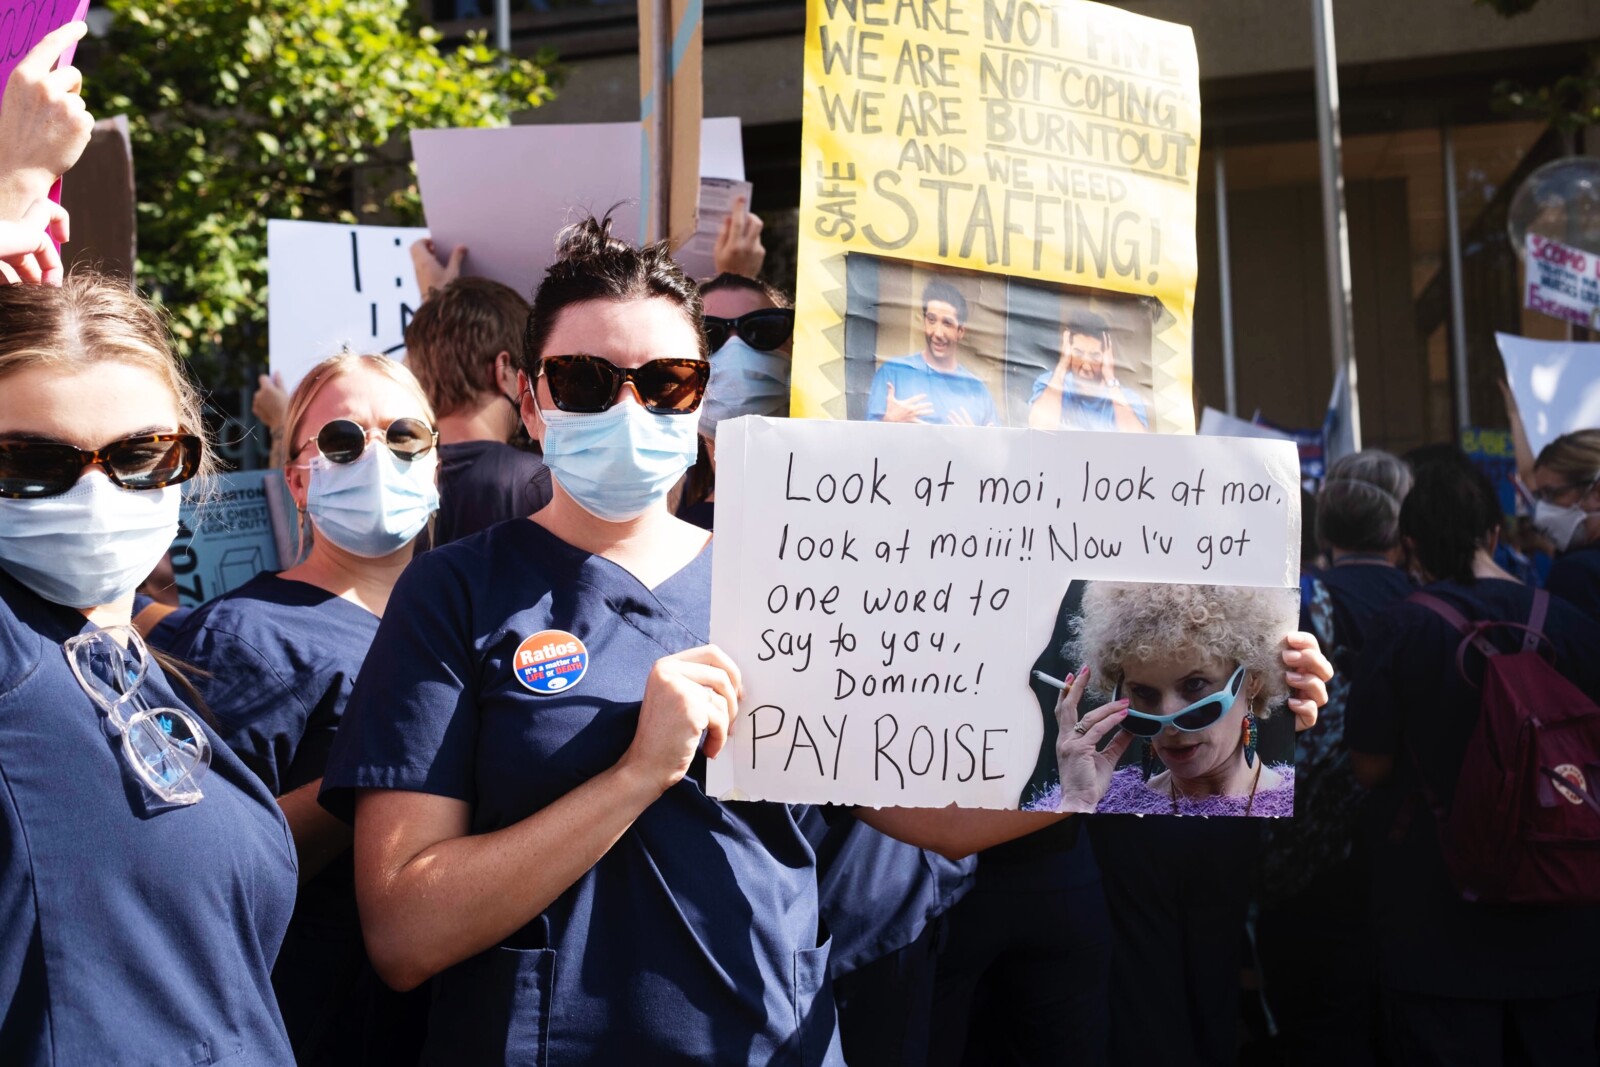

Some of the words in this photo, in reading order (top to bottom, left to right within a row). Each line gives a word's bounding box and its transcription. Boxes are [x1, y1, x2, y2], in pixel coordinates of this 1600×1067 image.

[893, 0, 968, 36] ARE
[984, 0, 1061, 49] NOT
[1086, 22, 1180, 77] FINE
[819, 25, 886, 82] WE
[893, 40, 960, 88] ARE
[979, 51, 1057, 100] NOT
[1060, 66, 1178, 129] COPING
[818, 86, 885, 135] WE
[896, 91, 966, 136] ARE
[898, 139, 966, 175] AND
[984, 152, 1034, 190] WE
[1047, 162, 1128, 204] NEED
[815, 160, 856, 242] SAFE
[861, 169, 1162, 286] STAFFING!
[786, 452, 891, 505] Look
[915, 461, 954, 506] at
[980, 472, 1060, 508] moi,
[1083, 462, 1154, 501] look
[1172, 469, 1205, 506] at
[1223, 483, 1280, 504] moi,
[779, 524, 858, 561] look
[876, 529, 909, 563] at
[1049, 523, 1121, 561] Now
[1197, 529, 1250, 569] got
[768, 585, 839, 614] one
[864, 583, 952, 614] word
[970, 580, 1009, 616] to
[520, 641, 578, 666] Ratios
[524, 666, 537, 676] It's
[545, 659, 570, 669] matter
[571, 655, 580, 663] of
[526, 671, 545, 682] LIFE
[556, 662, 583, 675] DEATH
[758, 629, 811, 672] say
[830, 623, 856, 656] to
[882, 631, 960, 666] you,
[748, 705, 847, 780] PAY
[875, 714, 1008, 789] ROISE
